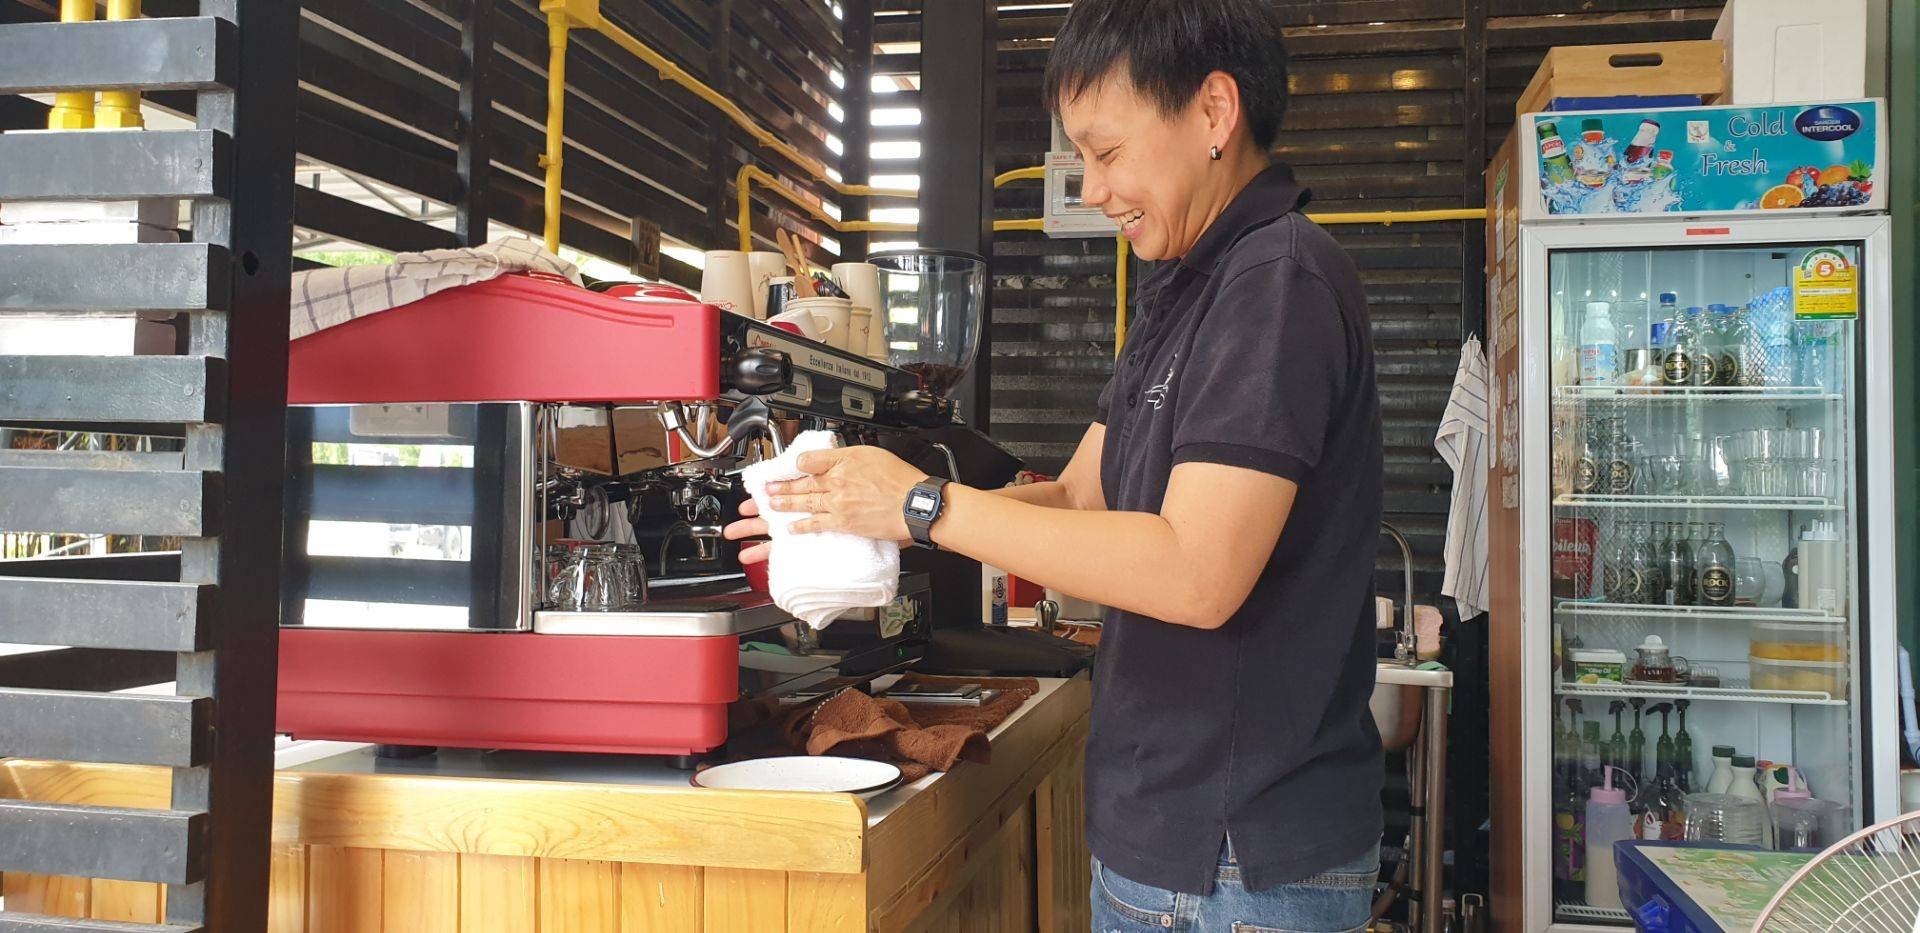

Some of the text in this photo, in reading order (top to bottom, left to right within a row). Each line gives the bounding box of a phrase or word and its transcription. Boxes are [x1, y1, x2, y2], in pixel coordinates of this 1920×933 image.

[1728, 110, 1787, 137] Cold
[1802, 124, 1854, 133] INTERCOOL
[1723, 140, 1736, 152] &
[1701, 148, 1769, 176] Fresh
[1819, 264, 1831, 276] 5
